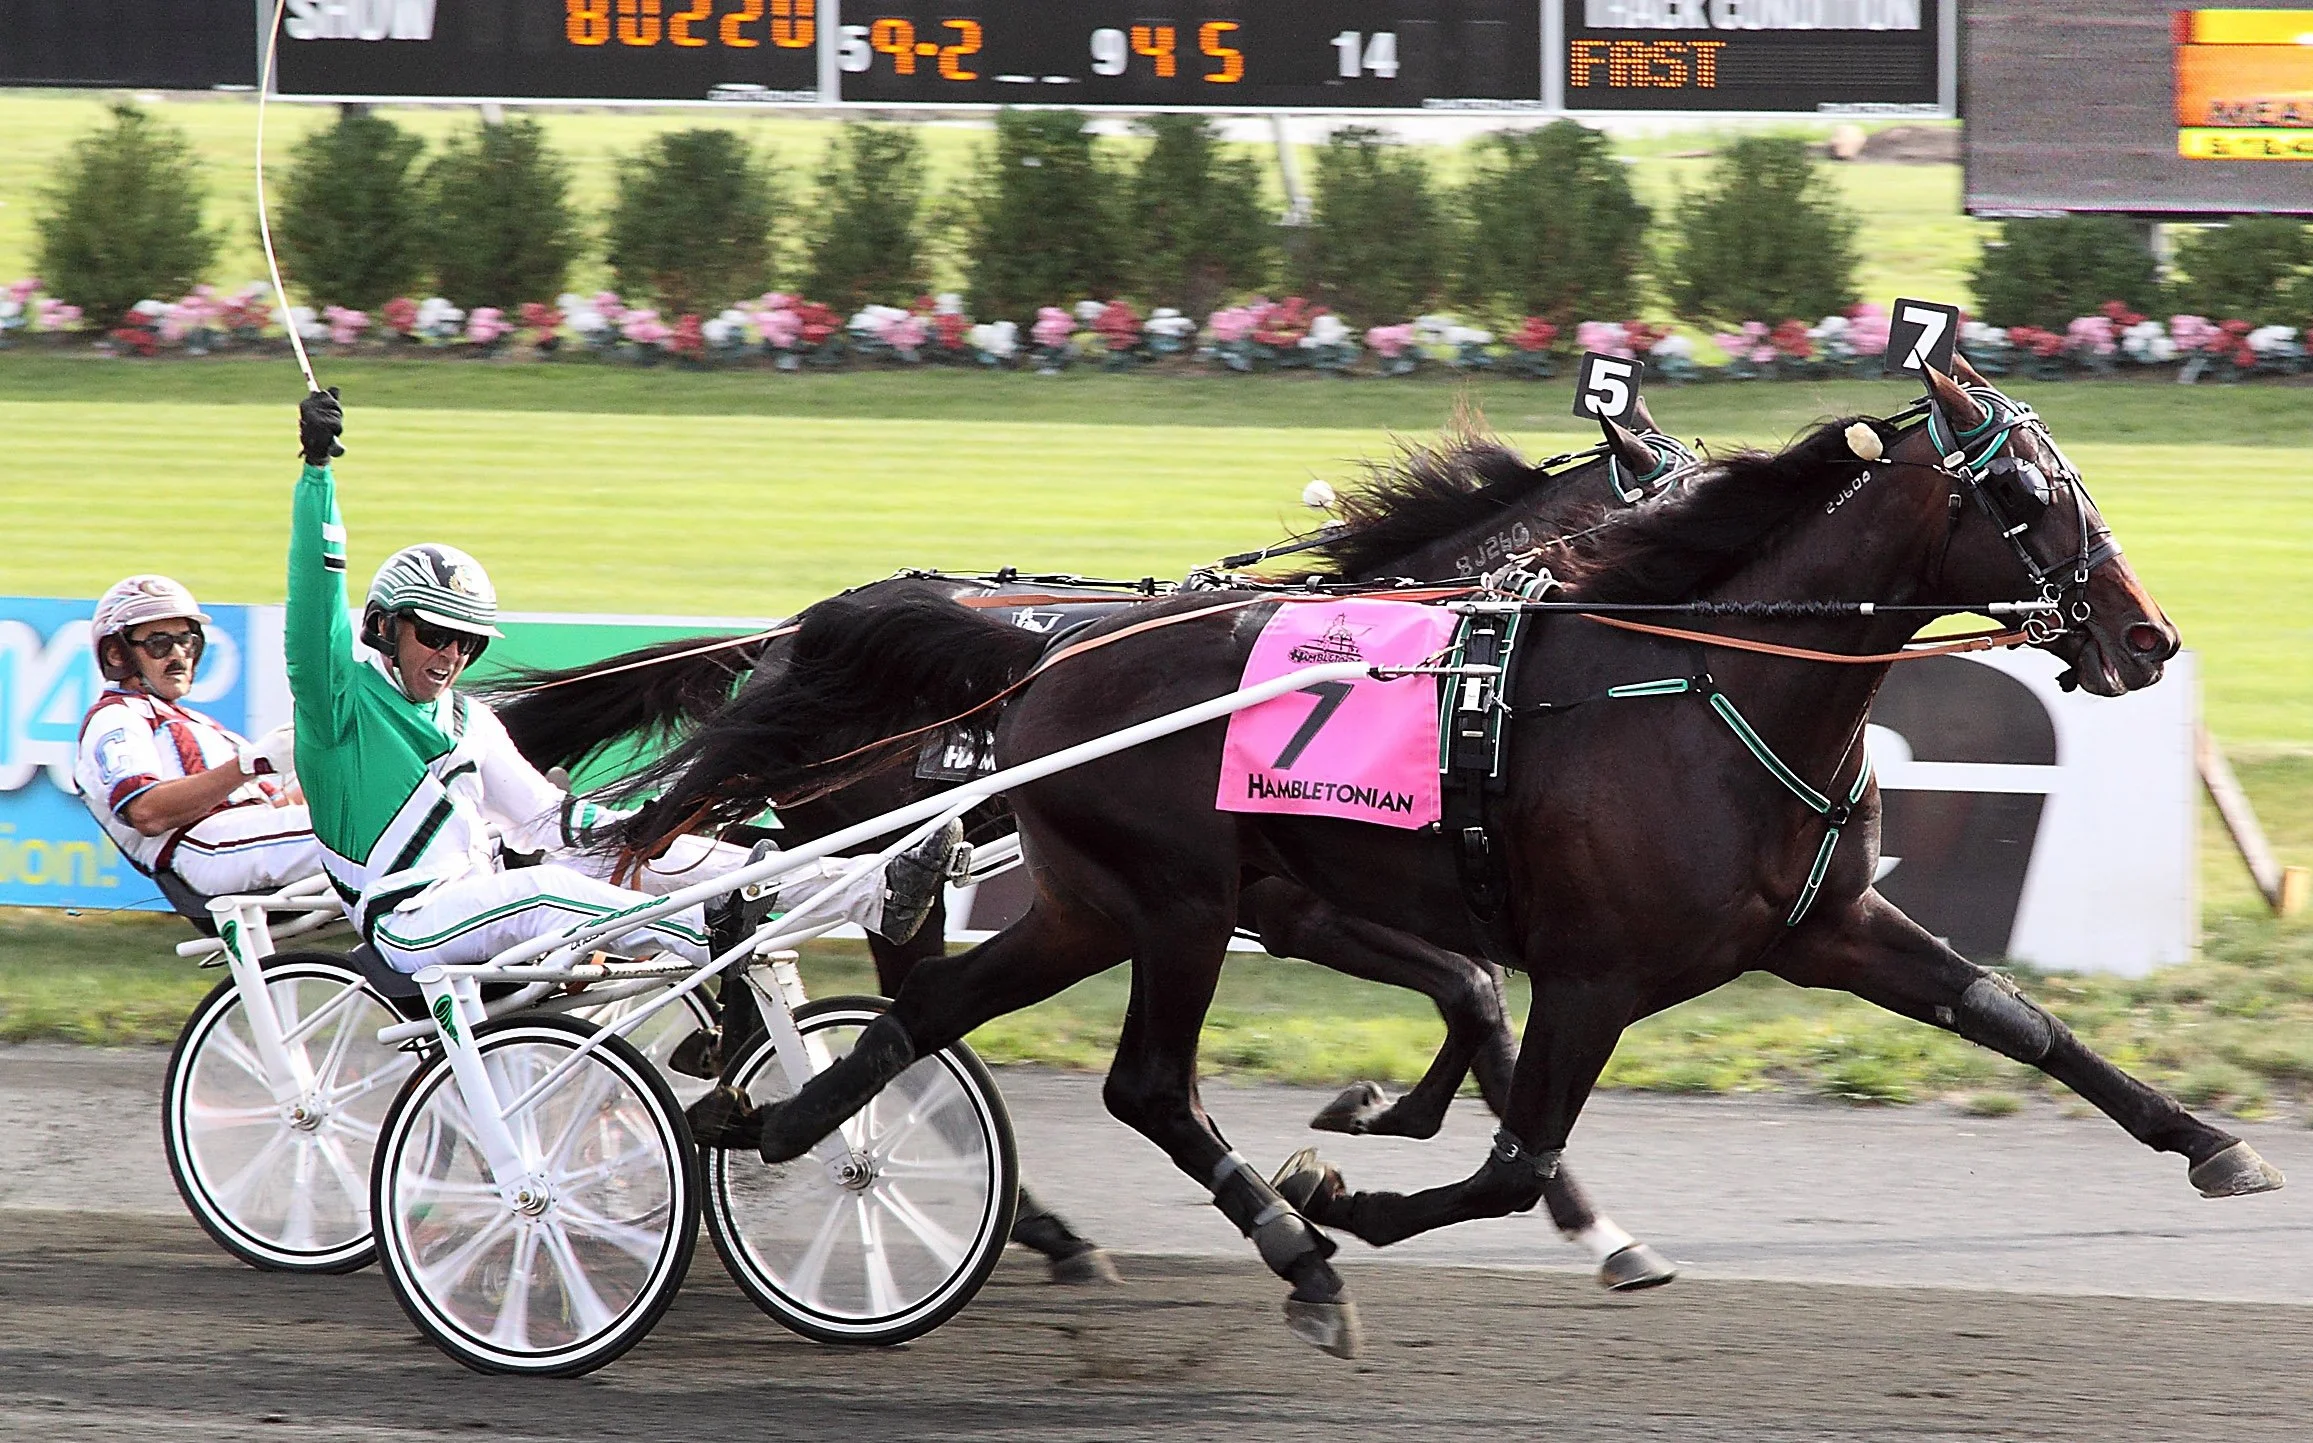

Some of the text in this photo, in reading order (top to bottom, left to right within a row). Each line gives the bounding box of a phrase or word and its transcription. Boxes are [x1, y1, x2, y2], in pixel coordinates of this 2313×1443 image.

[564, 0, 817, 47] 80220
[1090, 28, 1127, 76] 9
[1330, 30, 1399, 78] 14
[1570, 40, 1727, 88] FAST
[1903, 306, 1947, 370] 7
[1584, 357, 1632, 418] 5
[1270, 680, 1355, 770] 7
[1247, 772, 1415, 815] HAMBLETONIAN
